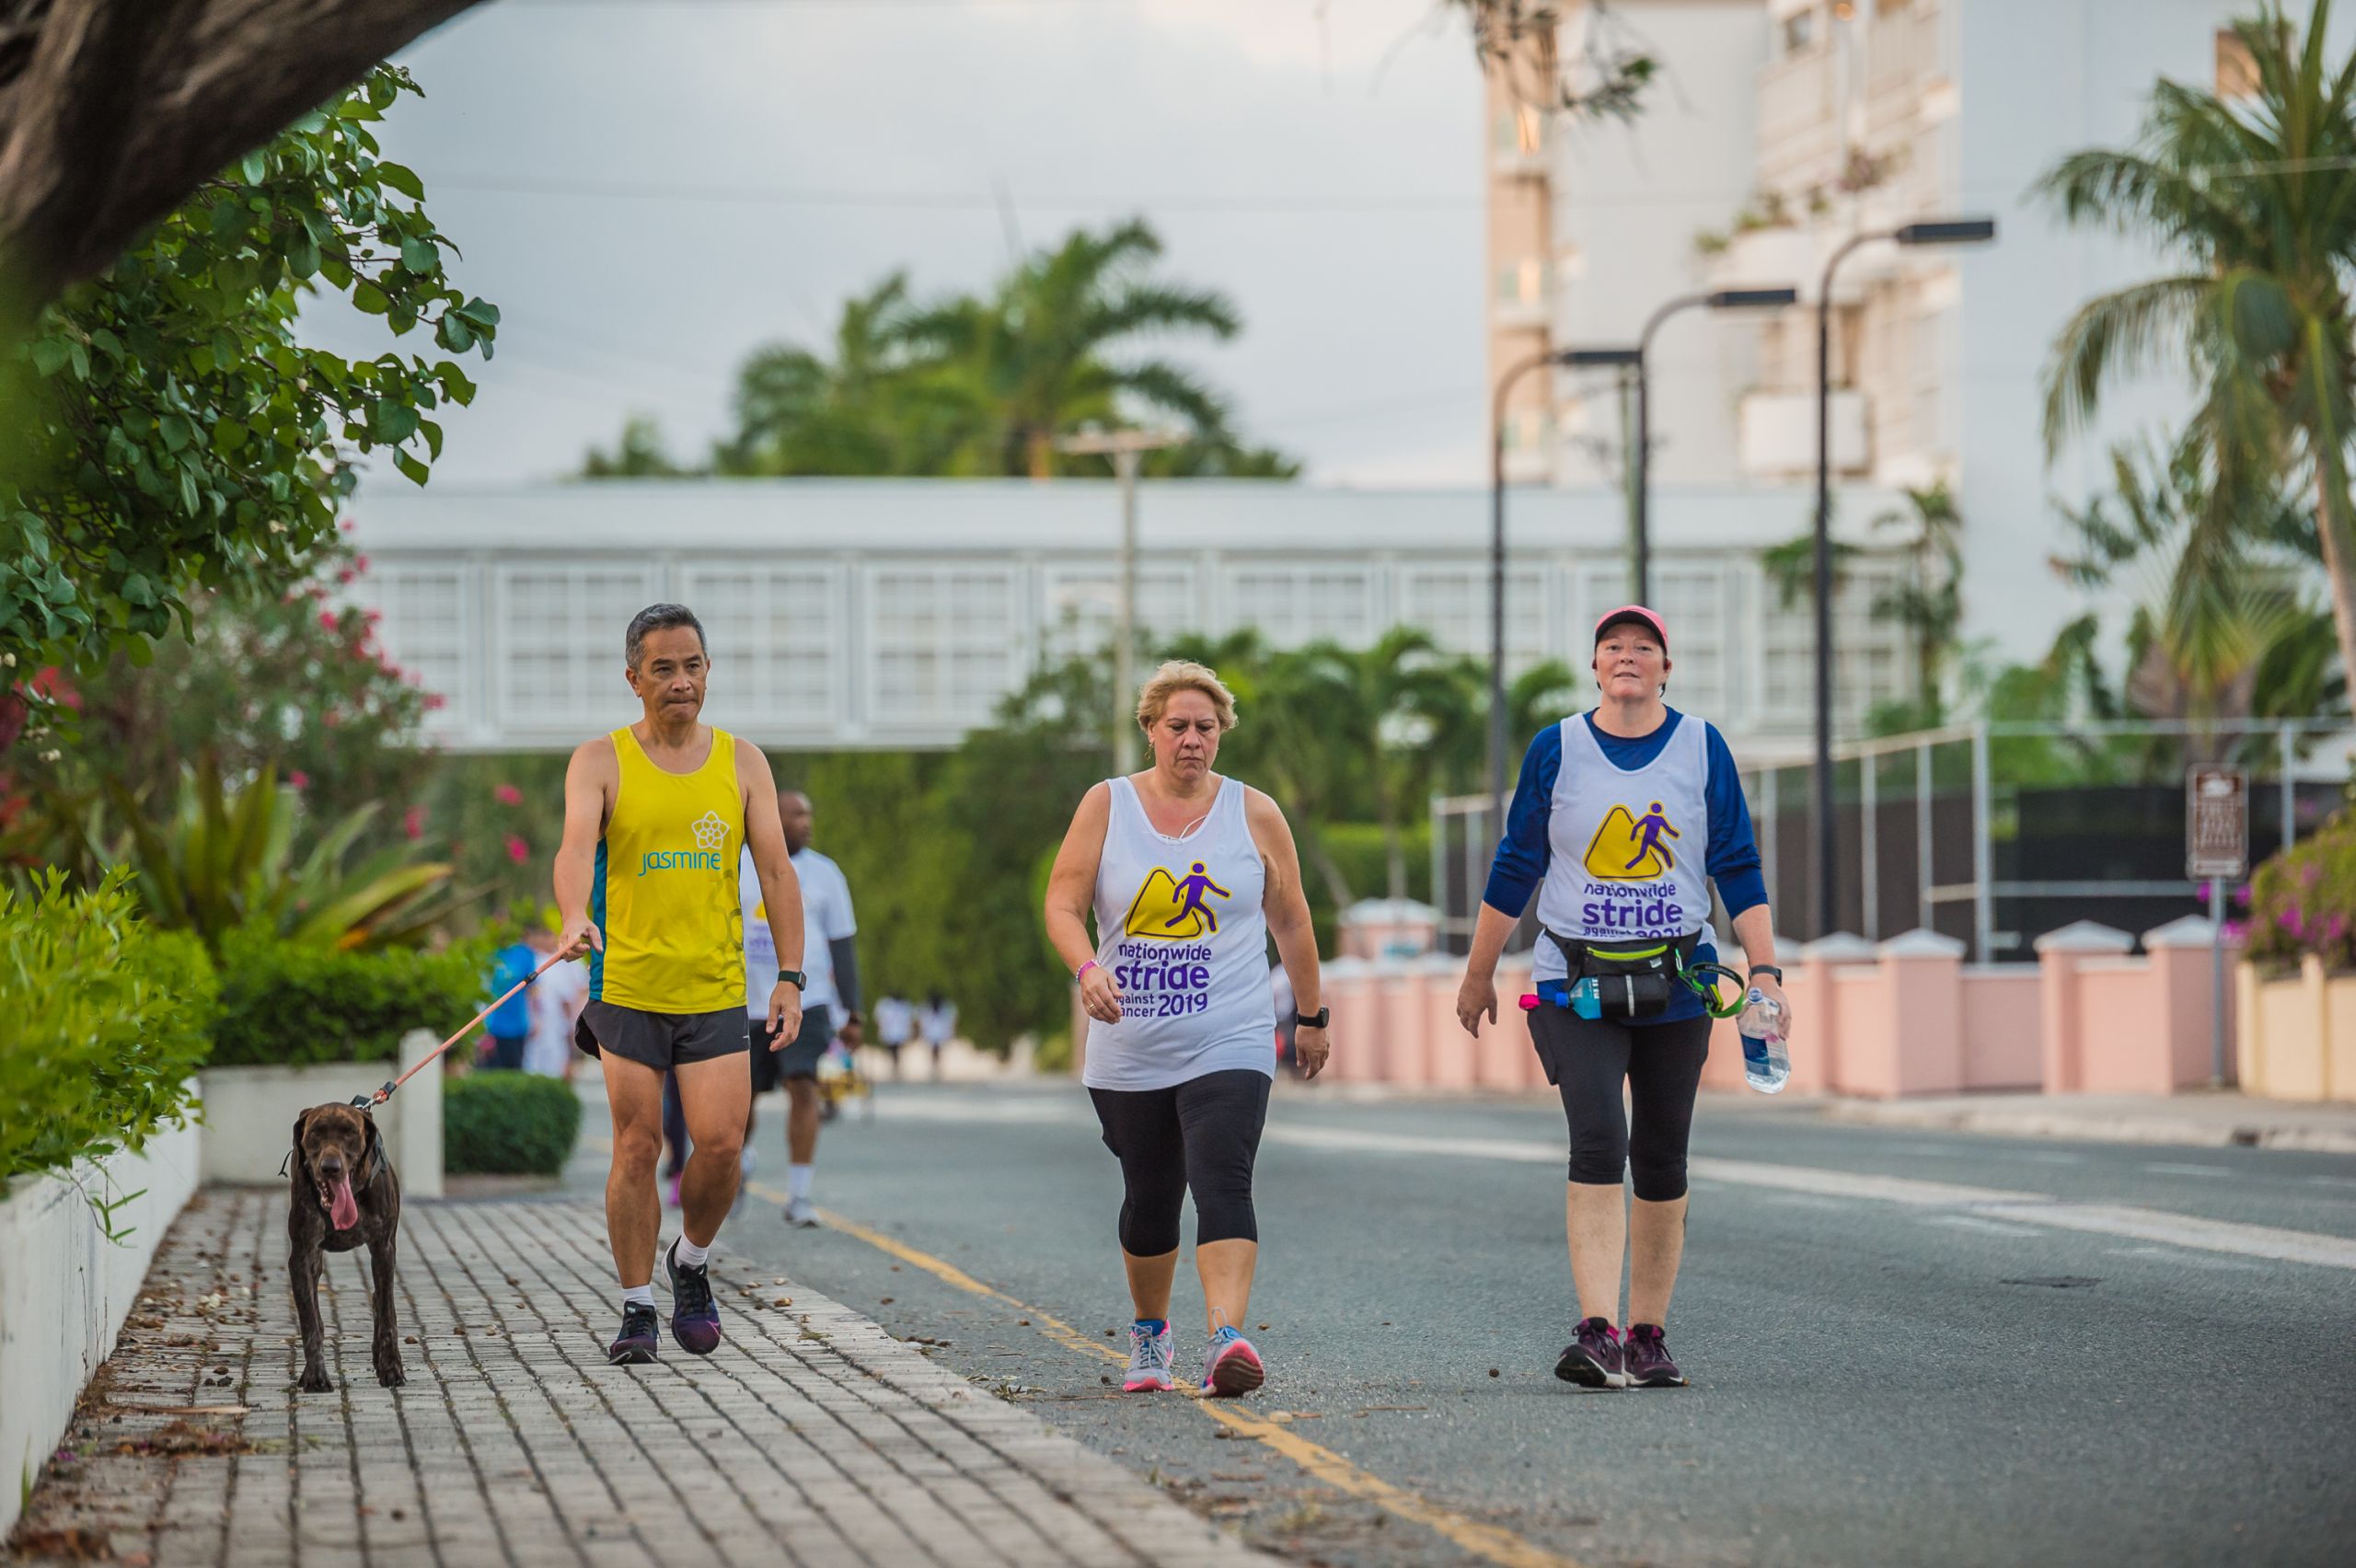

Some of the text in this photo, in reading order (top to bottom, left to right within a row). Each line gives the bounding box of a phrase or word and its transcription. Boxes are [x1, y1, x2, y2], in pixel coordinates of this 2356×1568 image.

[637, 851, 722, 877] jasmine
[1584, 882, 1677, 898] nationwide
[1582, 898, 1683, 927] stride
[1118, 942, 1212, 961] nationwide
[1114, 960, 1210, 990] stride
[1120, 1007, 1156, 1018] ancer
[1157, 993, 1208, 1017] 2019
